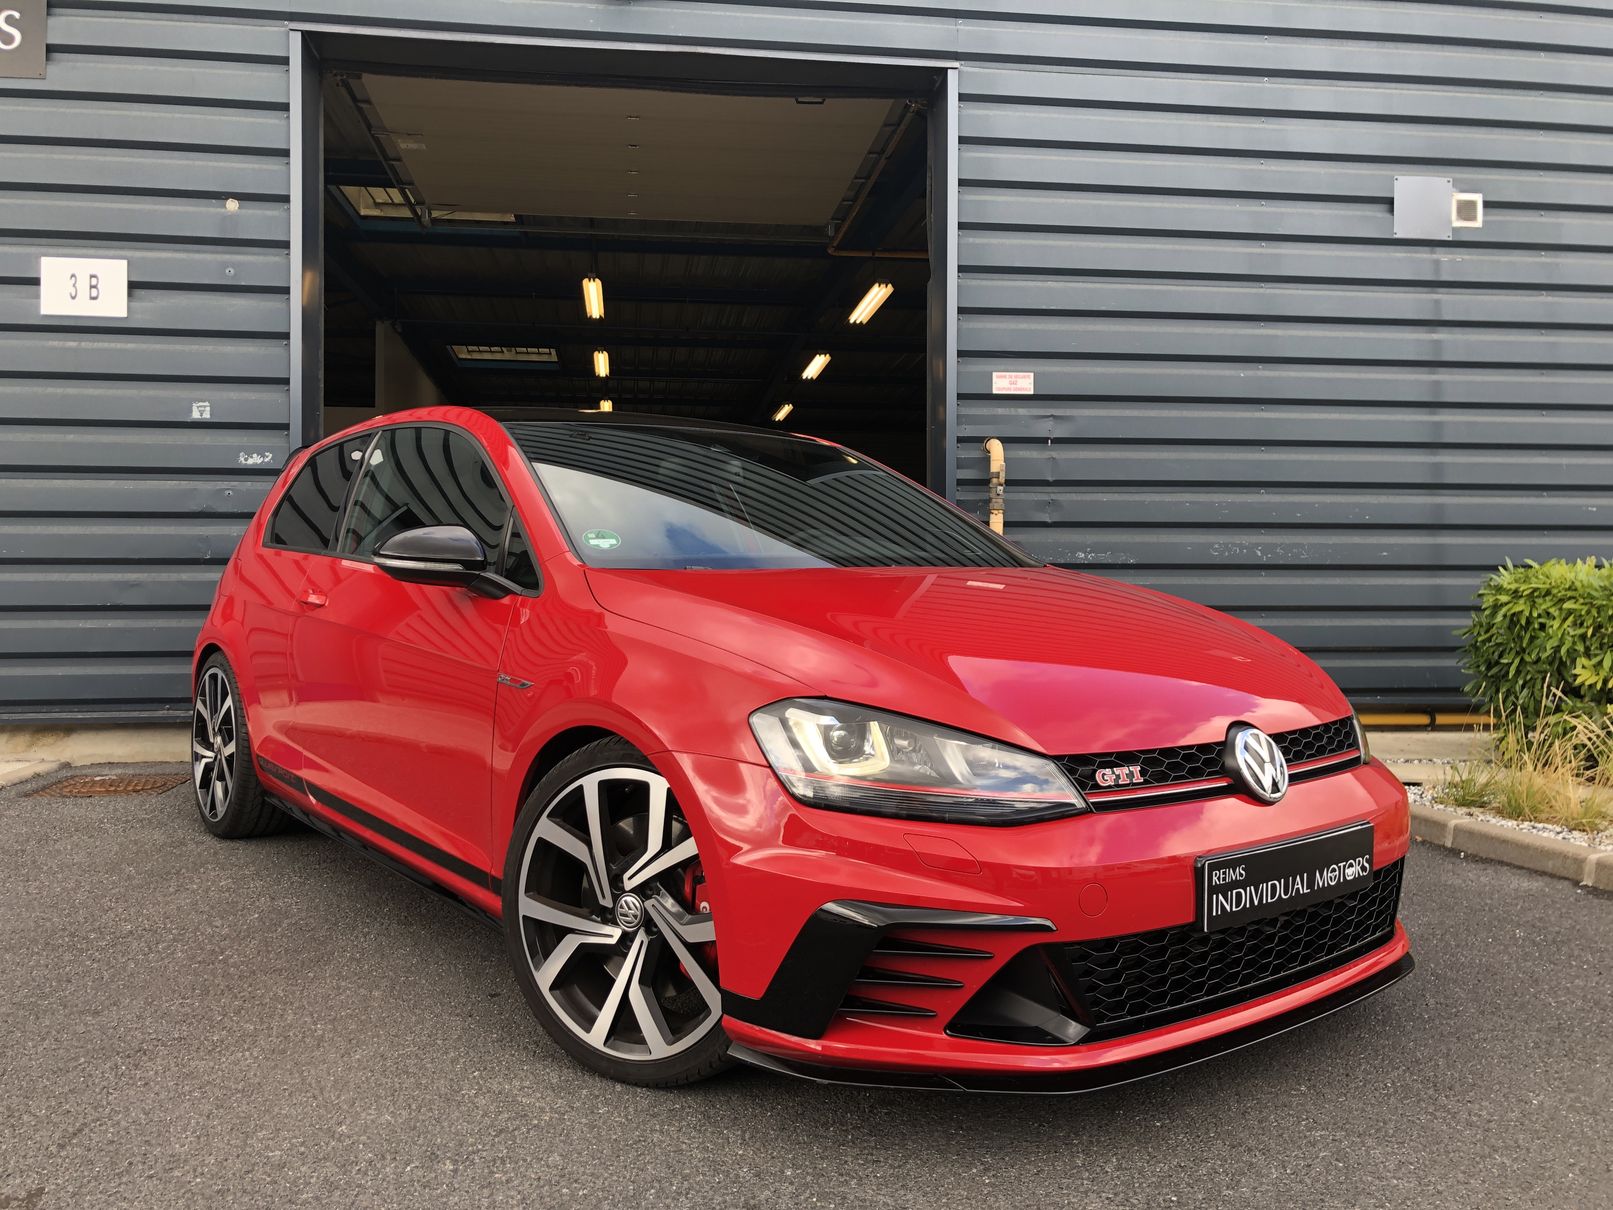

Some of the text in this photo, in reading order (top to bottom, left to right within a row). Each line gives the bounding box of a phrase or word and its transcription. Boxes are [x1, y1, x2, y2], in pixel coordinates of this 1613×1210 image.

[69, 272, 100, 301] 3 B
[1095, 765, 1144, 787] GTI
[1212, 864, 1246, 886] REIMS
[1212, 854, 1370, 916] INDIVIDUAL MOTORS
